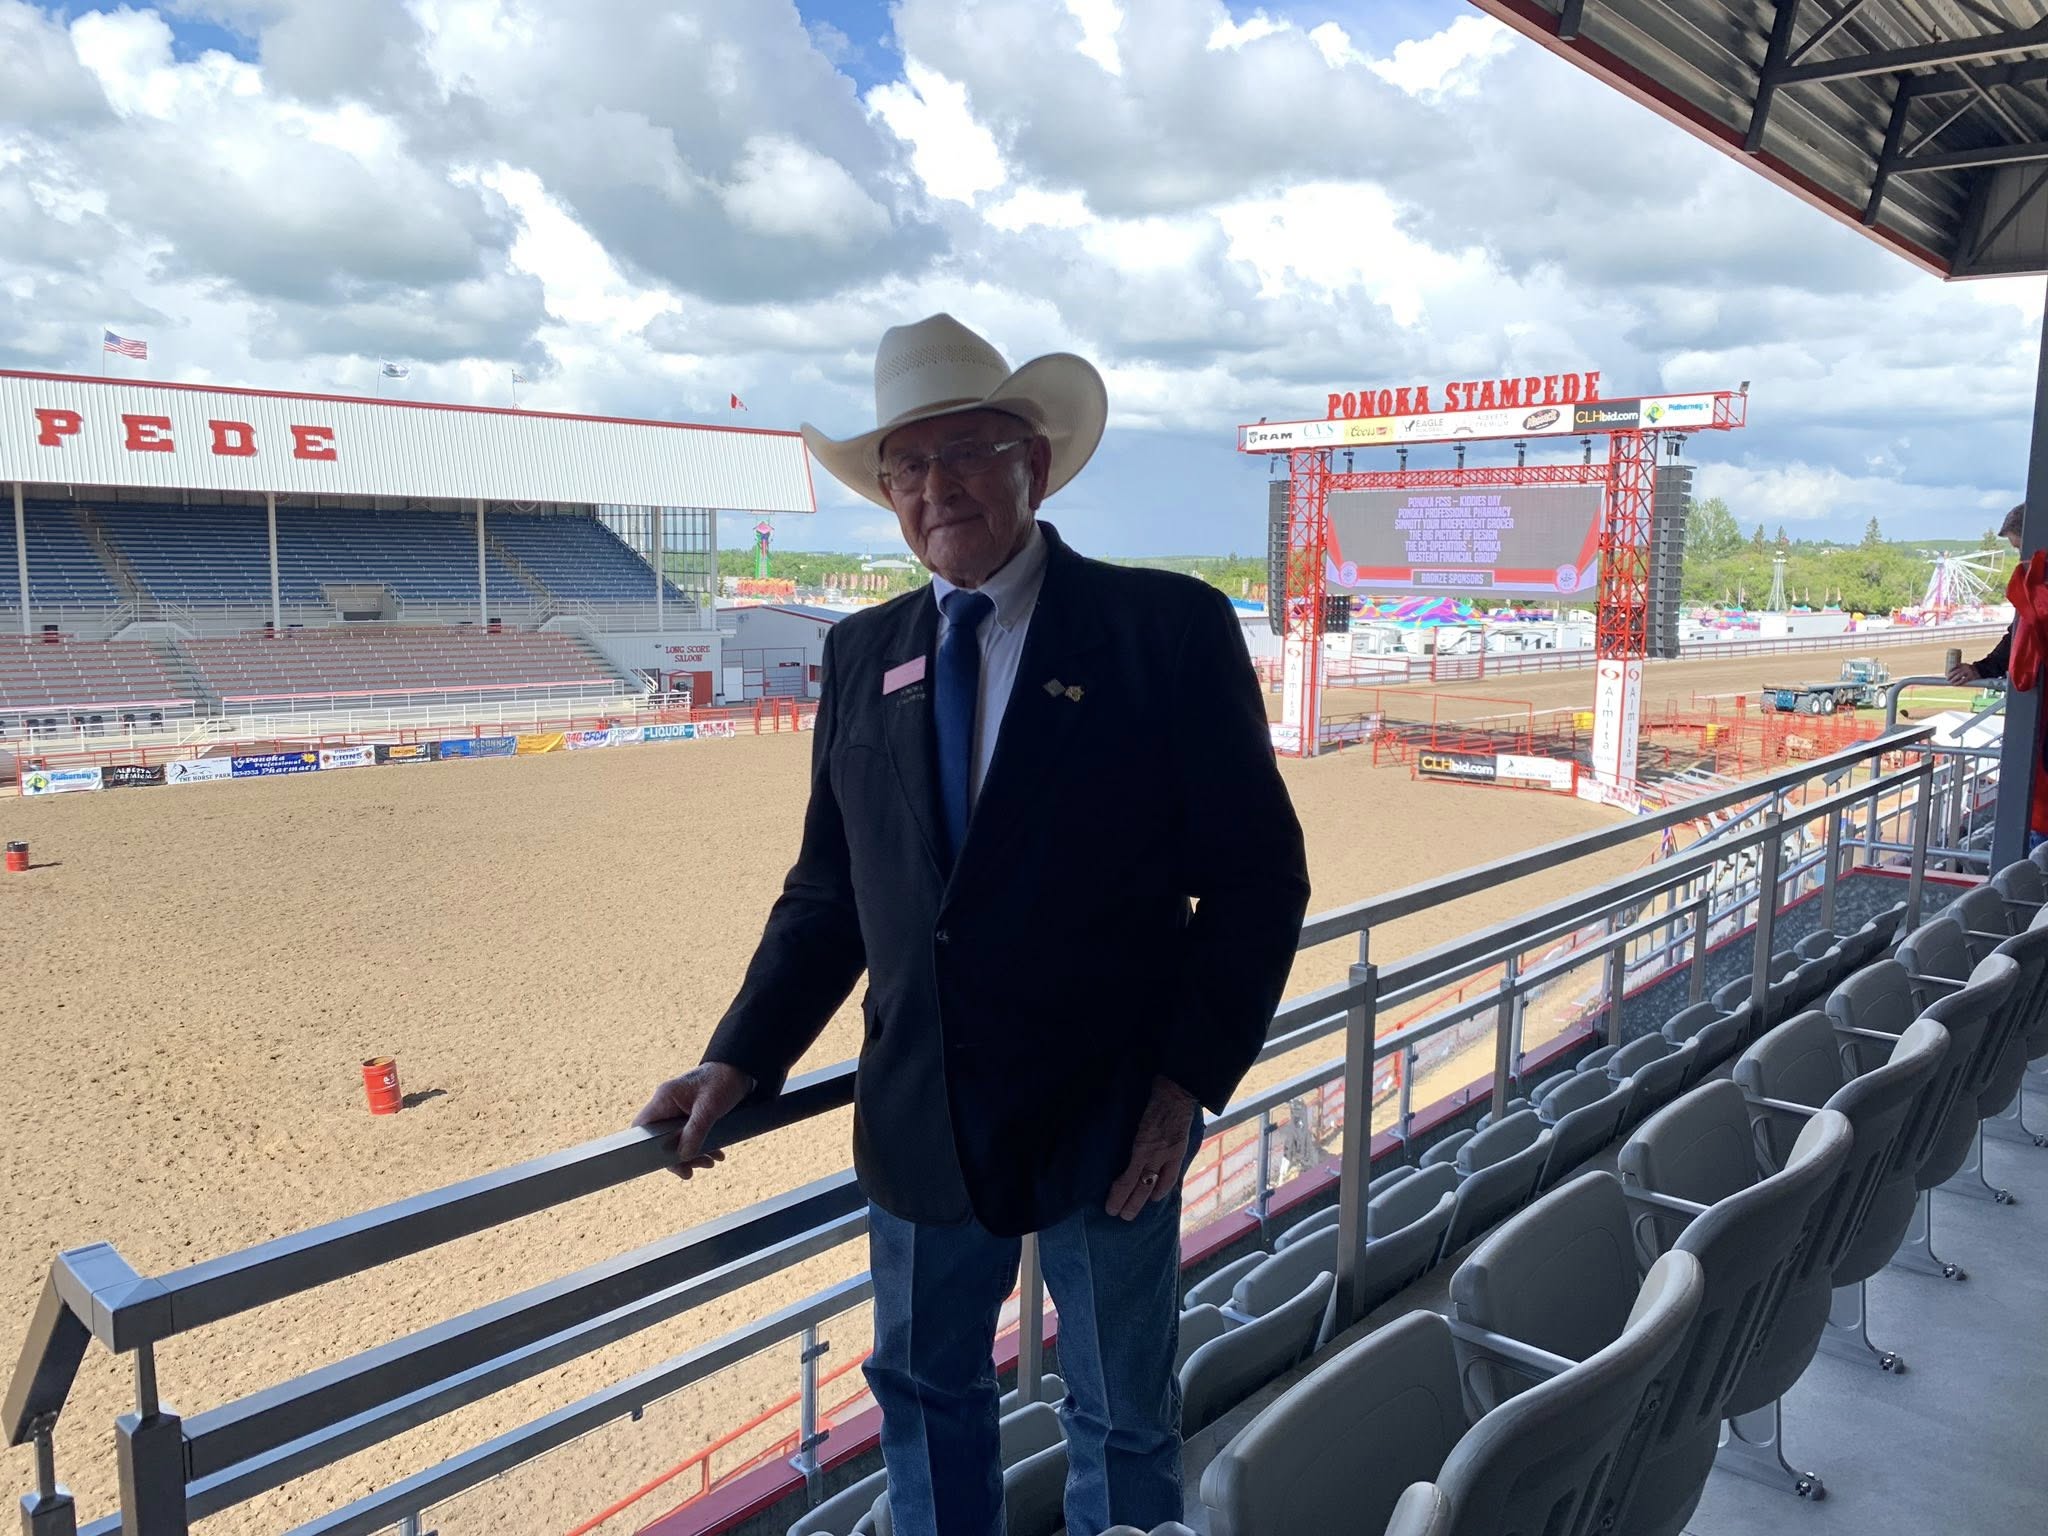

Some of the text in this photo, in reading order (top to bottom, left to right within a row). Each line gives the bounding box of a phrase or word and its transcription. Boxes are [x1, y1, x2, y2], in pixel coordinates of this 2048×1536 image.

[1327, 371, 1601, 420] PONOKA STAMPEDE
[1575, 410, 1639, 424] CLHbid.com
[1415, 419, 1444, 428] EAGLE
[35, 408, 337, 461] PEDE
[1259, 432, 1293, 441] RAM
[665, 645, 710, 654] LONG SCORE
[650, 726, 686, 738] LIQUOR
[245, 755, 285, 763] Ponoka
[261, 764, 317, 775] Pharmacy
[1421, 756, 1494, 775] CLHbid.com
